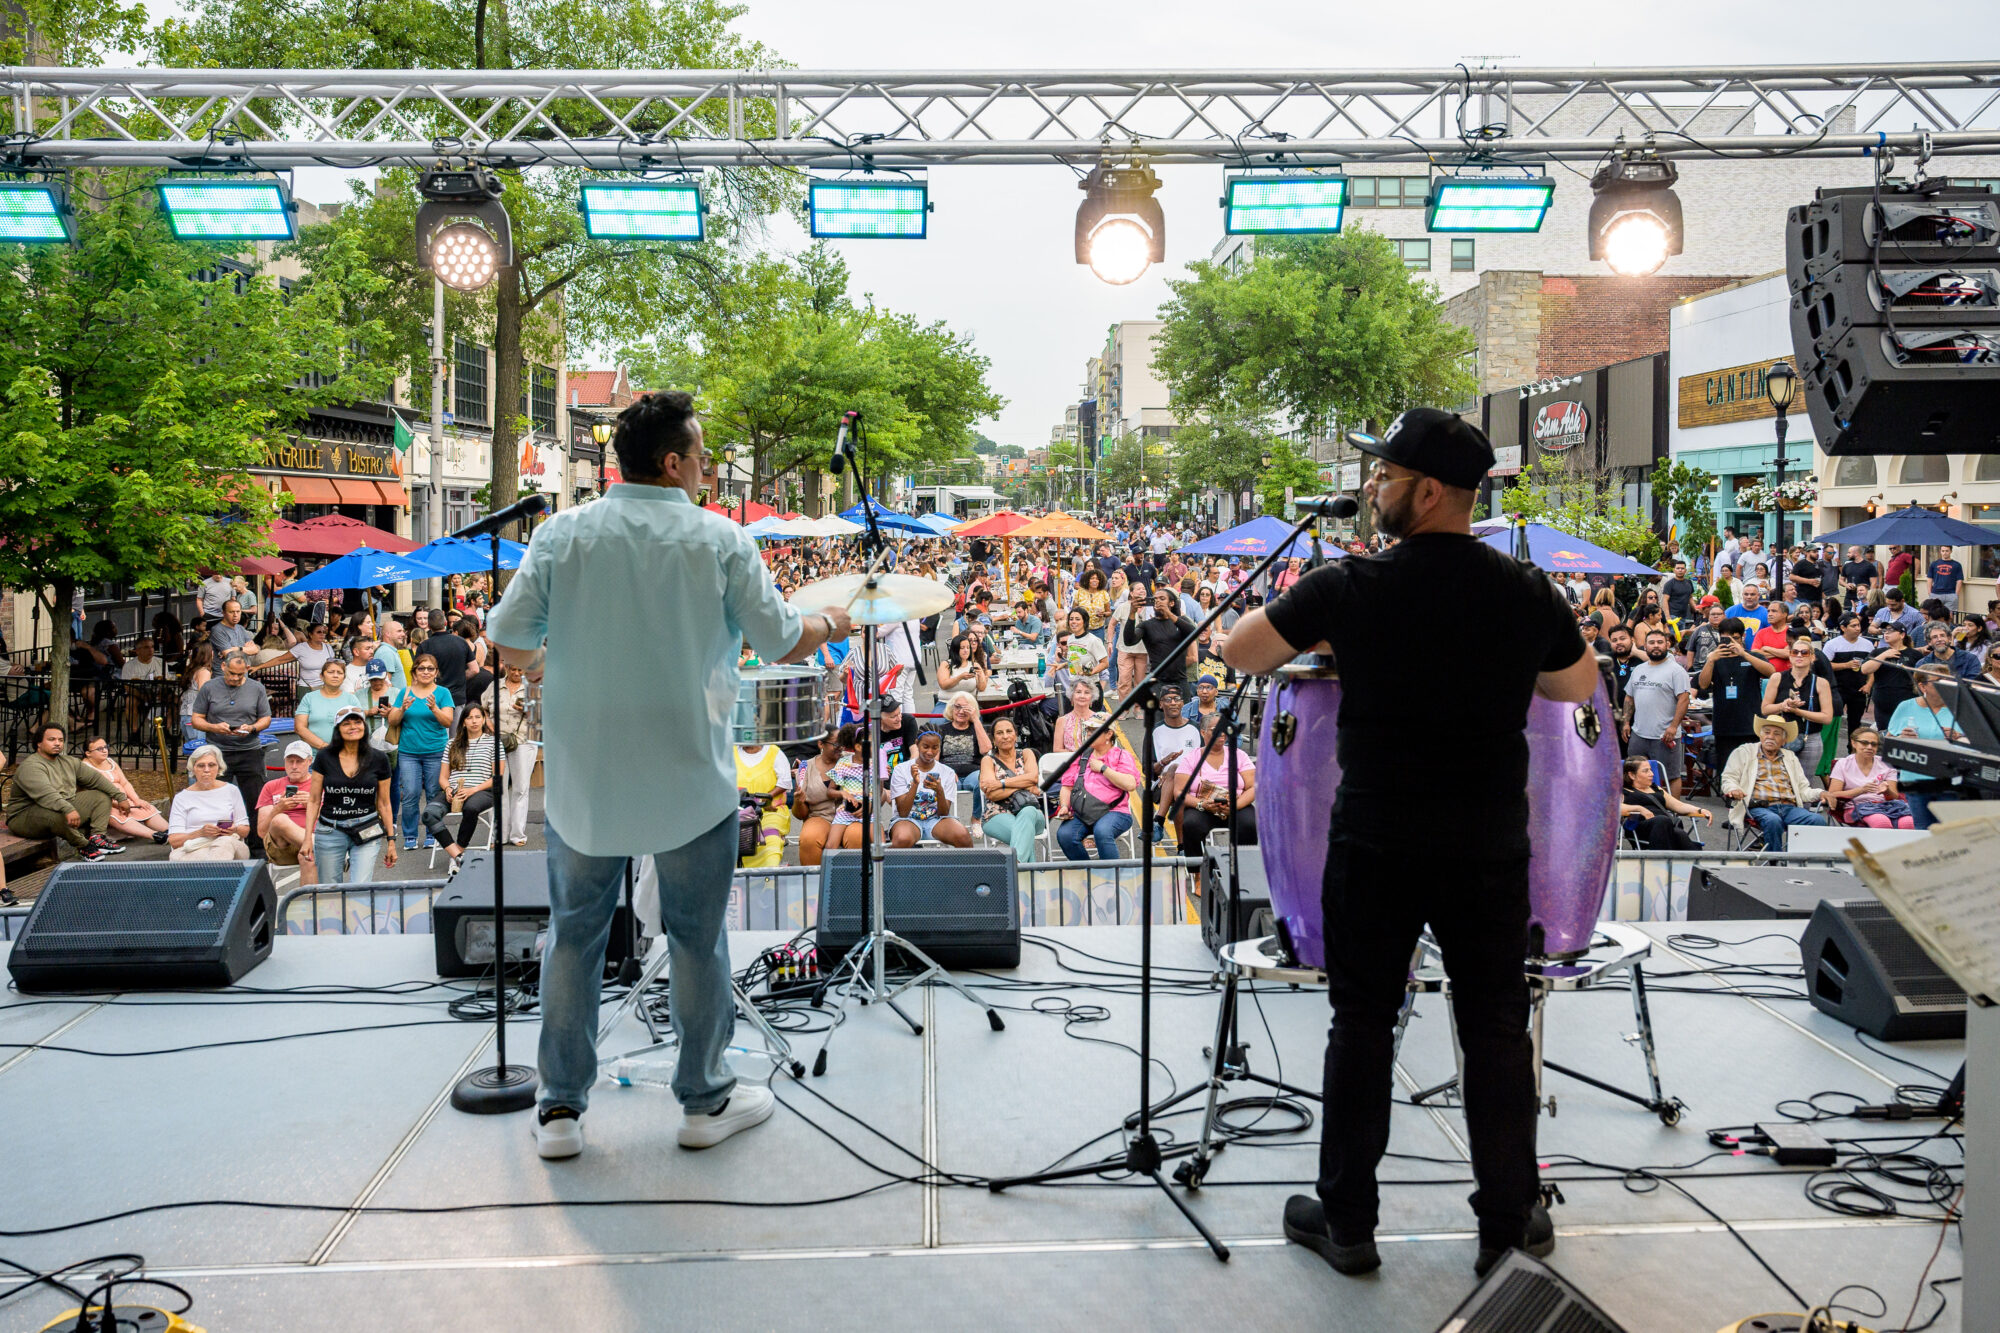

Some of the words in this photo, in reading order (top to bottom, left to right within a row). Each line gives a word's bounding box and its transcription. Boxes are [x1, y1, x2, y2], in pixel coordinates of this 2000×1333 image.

[1706, 367, 1767, 406] CANTIN
[1536, 406, 1559, 438] Sam
[1560, 401, 1582, 435] Ash
[1561, 433, 1584, 445] TORES
[279, 446, 324, 470] GRILLE
[347, 448, 384, 475] BISTRO
[1551, 560, 1577, 568] Red
[1577, 560, 1603, 568] Bull
[1887, 747, 1928, 765] JUNO-D
[325, 786, 376, 795] Motivated
[343, 796, 356, 806] By
[332, 807, 370, 815] Mambo
